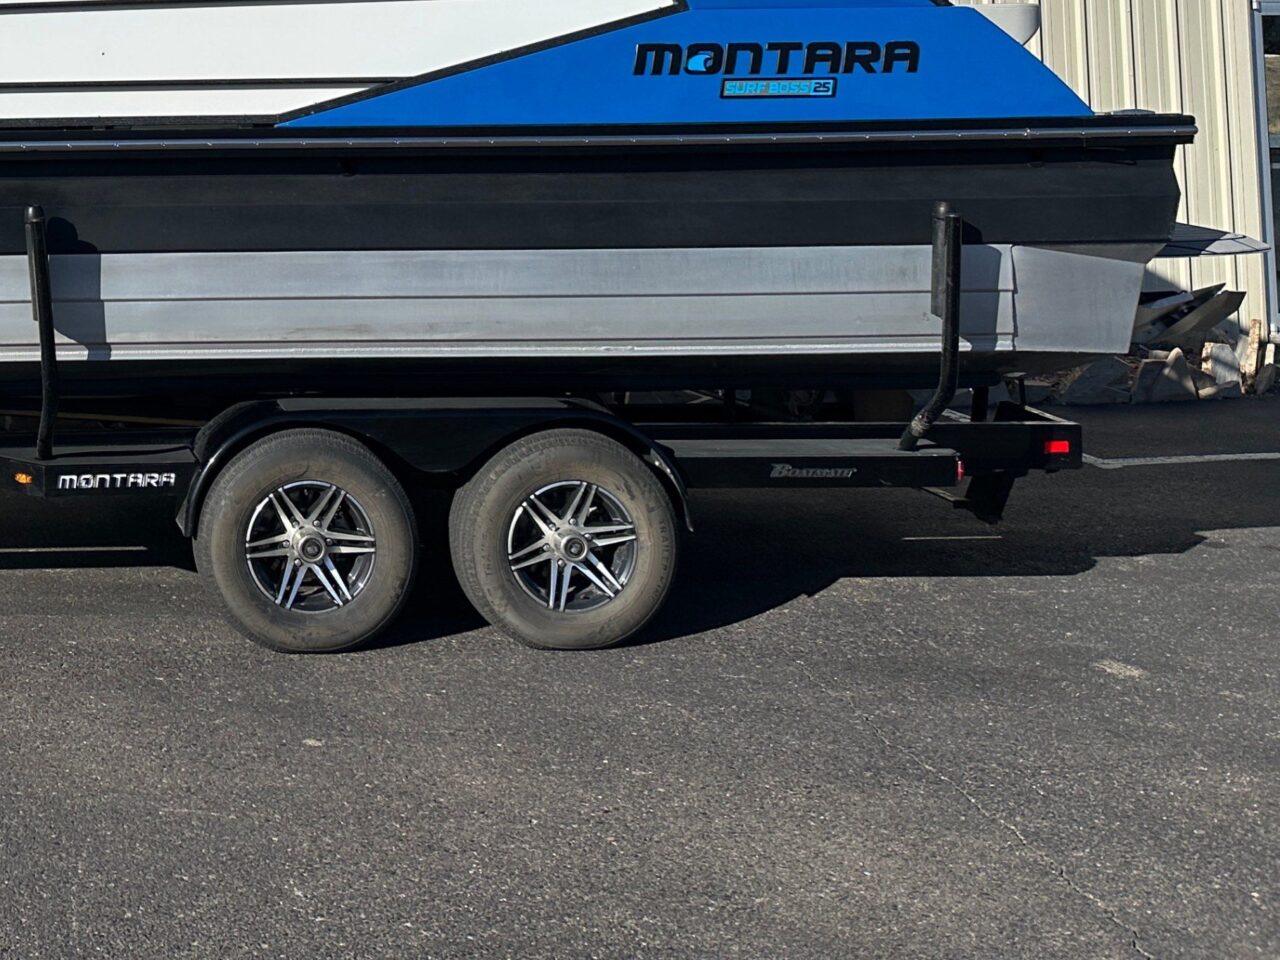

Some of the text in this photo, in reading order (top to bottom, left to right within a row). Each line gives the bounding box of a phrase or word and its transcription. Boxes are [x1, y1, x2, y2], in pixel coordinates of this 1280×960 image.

[632, 40, 920, 76] MONTARA
[725, 80, 832, 94] SURF BOSS 25
[58, 472, 176, 489] MONTARA
